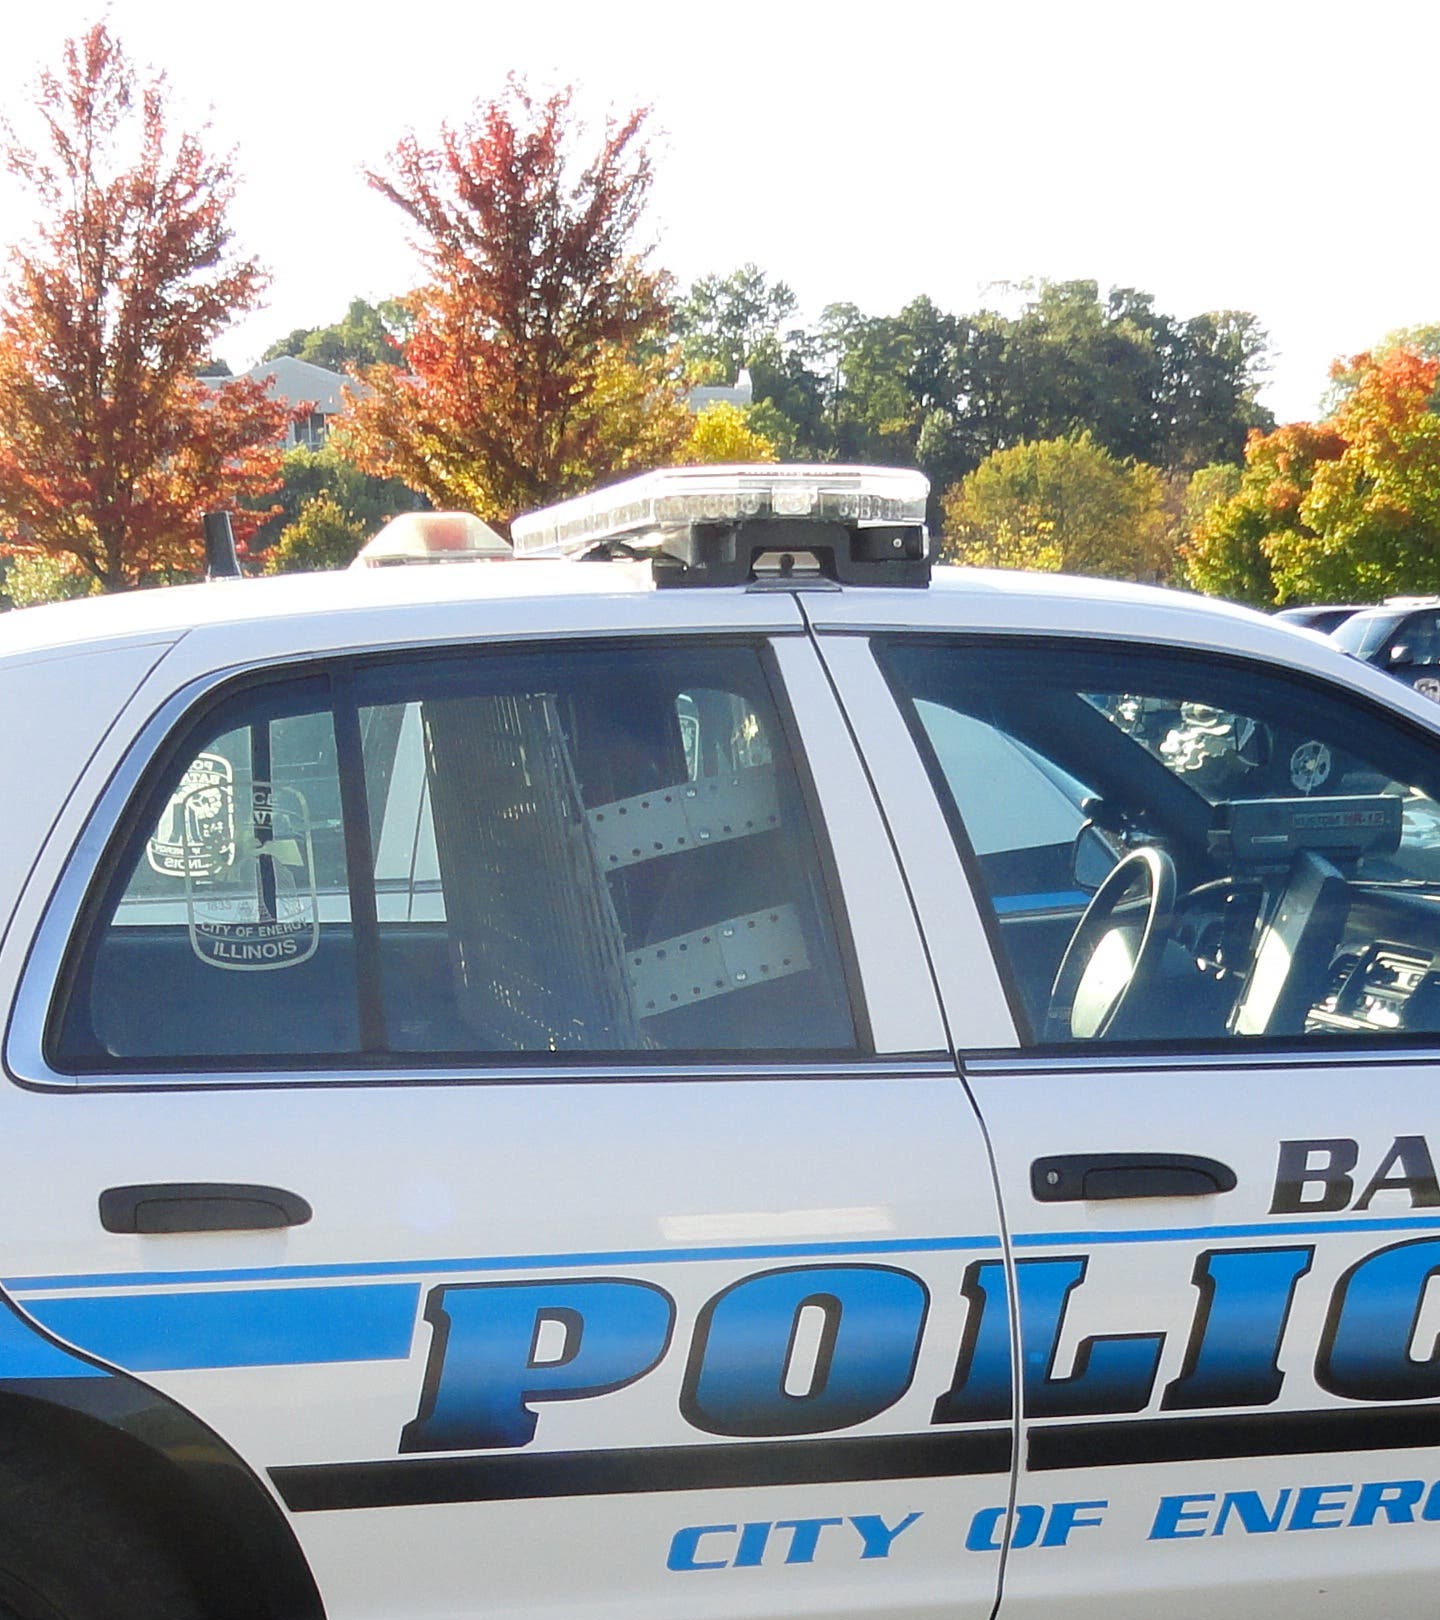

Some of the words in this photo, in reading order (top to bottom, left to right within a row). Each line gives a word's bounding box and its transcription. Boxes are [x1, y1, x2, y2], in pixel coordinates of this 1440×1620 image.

[201, 921, 231, 937] CITY
[235, 926, 253, 937] OF
[213, 939, 297, 959] ILLINOIS
[666, 1511, 923, 1572] CITY
[964, 1499, 1108, 1552] OF
